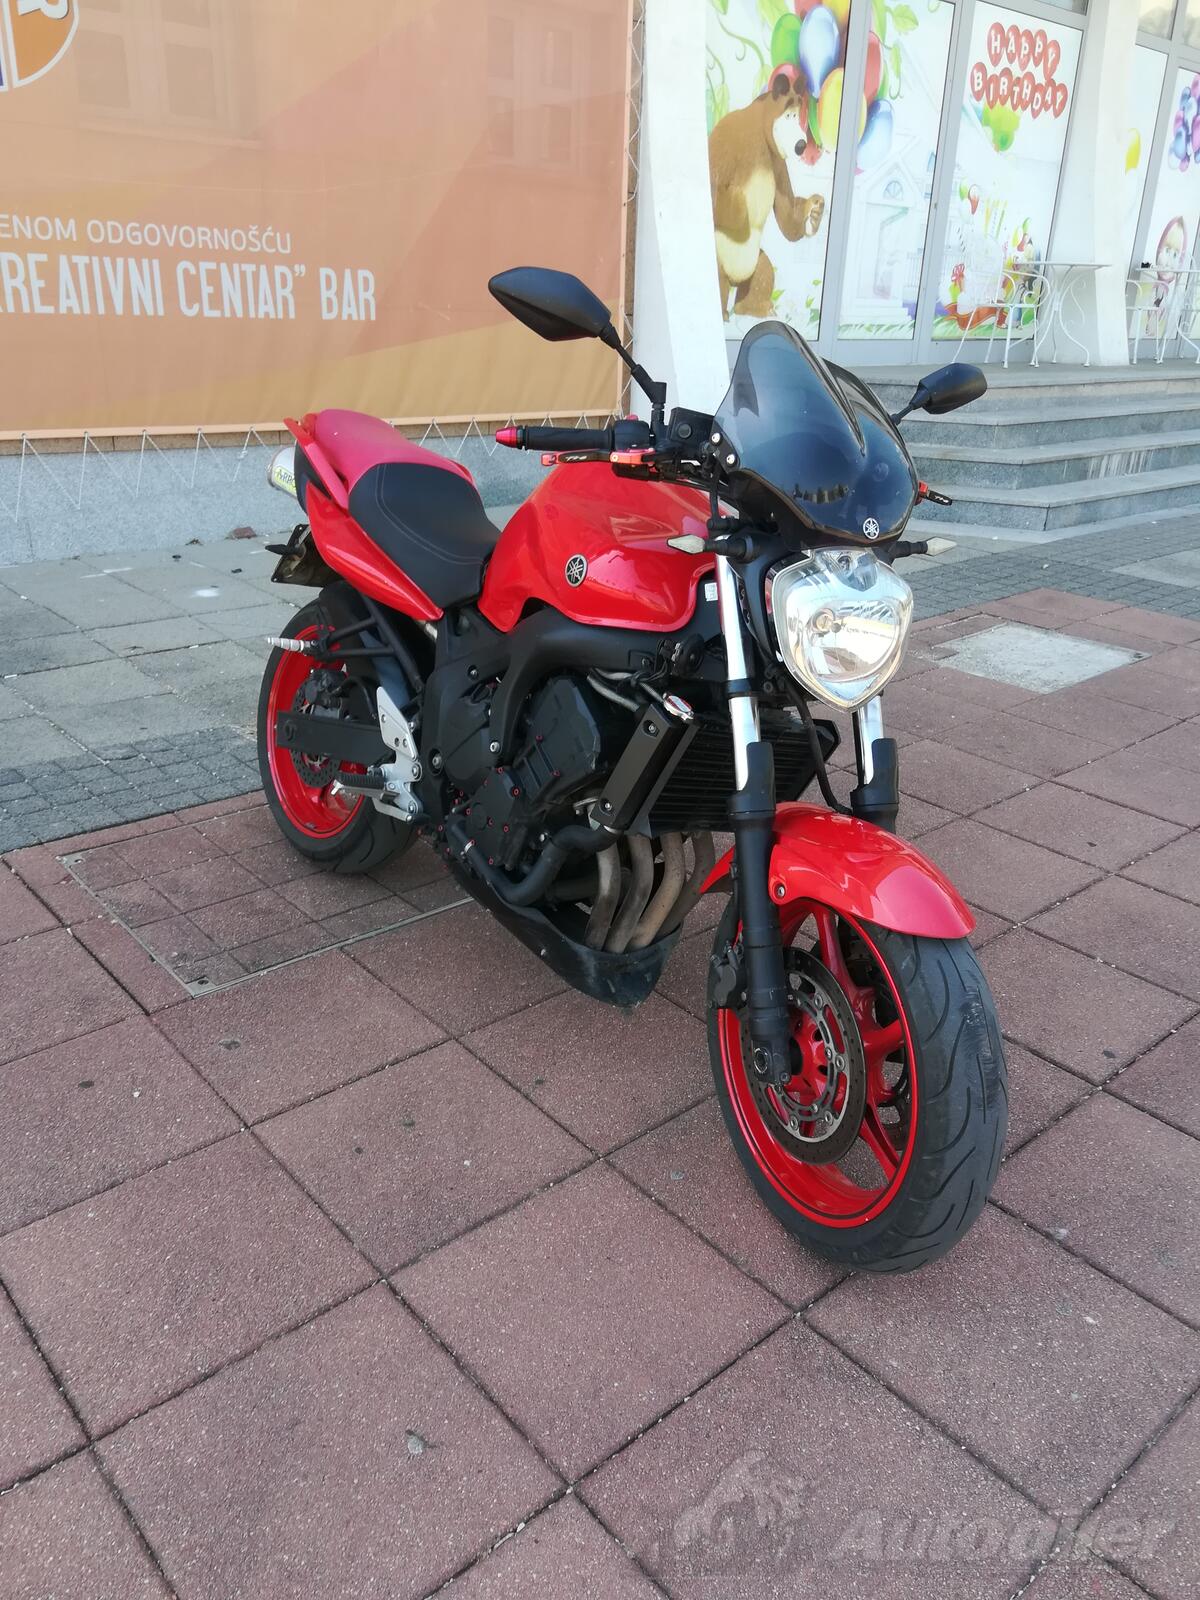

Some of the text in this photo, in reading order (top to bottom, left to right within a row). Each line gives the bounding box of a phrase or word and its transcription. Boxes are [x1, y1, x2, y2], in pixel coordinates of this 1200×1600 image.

[990, 28, 1057, 68] HAPPY
[974, 67, 1065, 111] BIRTHDAY
[86, 219, 292, 254] ODGOVORNOŠĆU
[0, 252, 165, 317] REATIVNI
[319, 267, 376, 320] BAR
